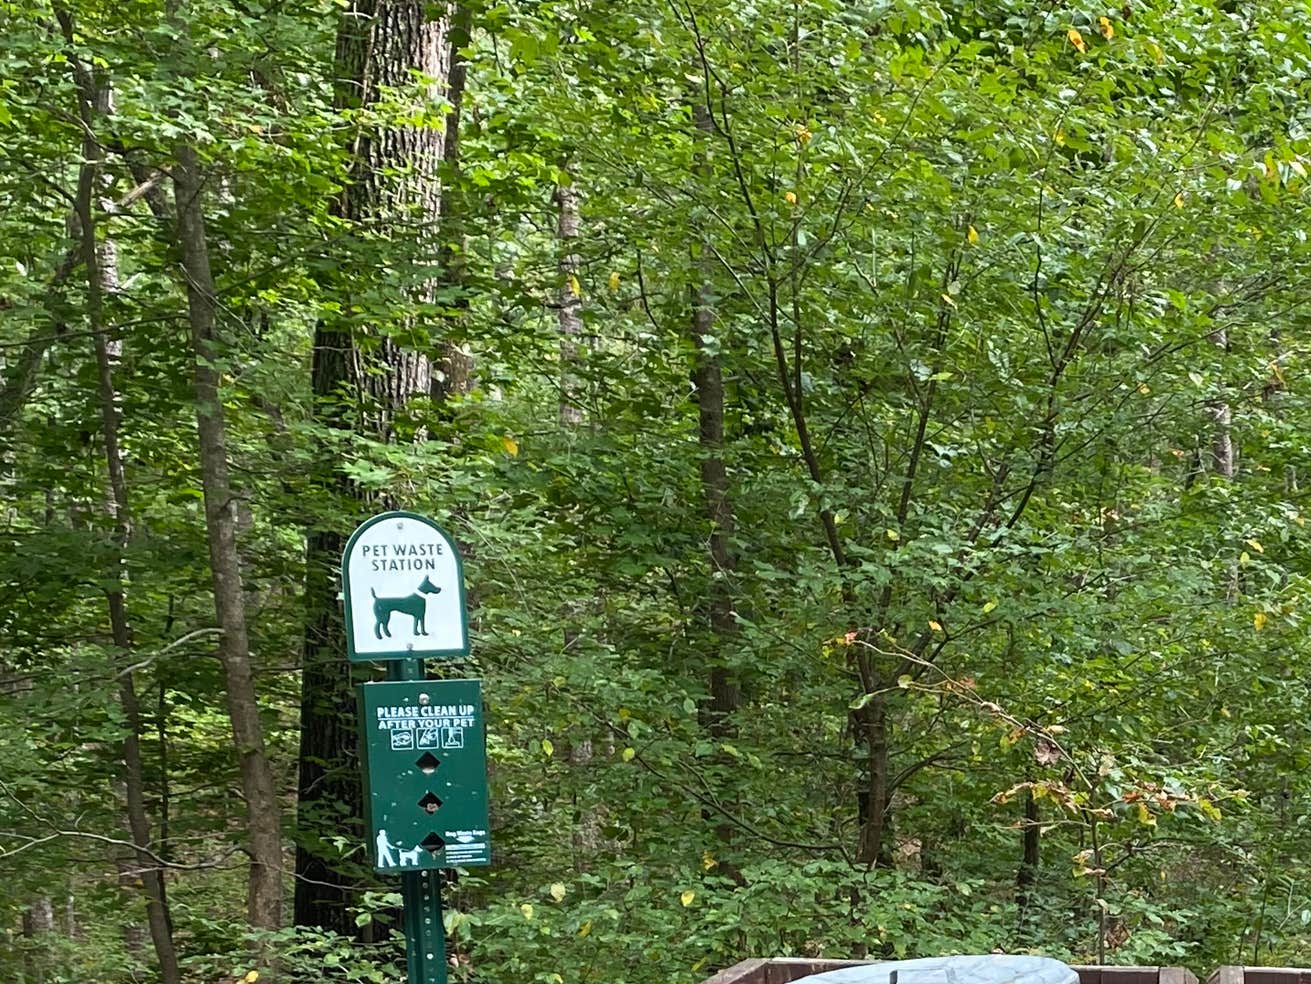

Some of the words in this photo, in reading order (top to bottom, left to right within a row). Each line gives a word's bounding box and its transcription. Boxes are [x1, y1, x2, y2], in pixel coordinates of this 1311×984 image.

[362, 544, 388, 557] PET
[392, 543, 444, 556] WASTE
[372, 558, 436, 571] STATION
[377, 707, 418, 717] PLEASE
[421, 706, 456, 716] CLEAN
[459, 705, 474, 715] UP
[379, 721, 415, 729] AFTER
[418, 719, 450, 728] YOUR
[453, 719, 474, 727] PET
